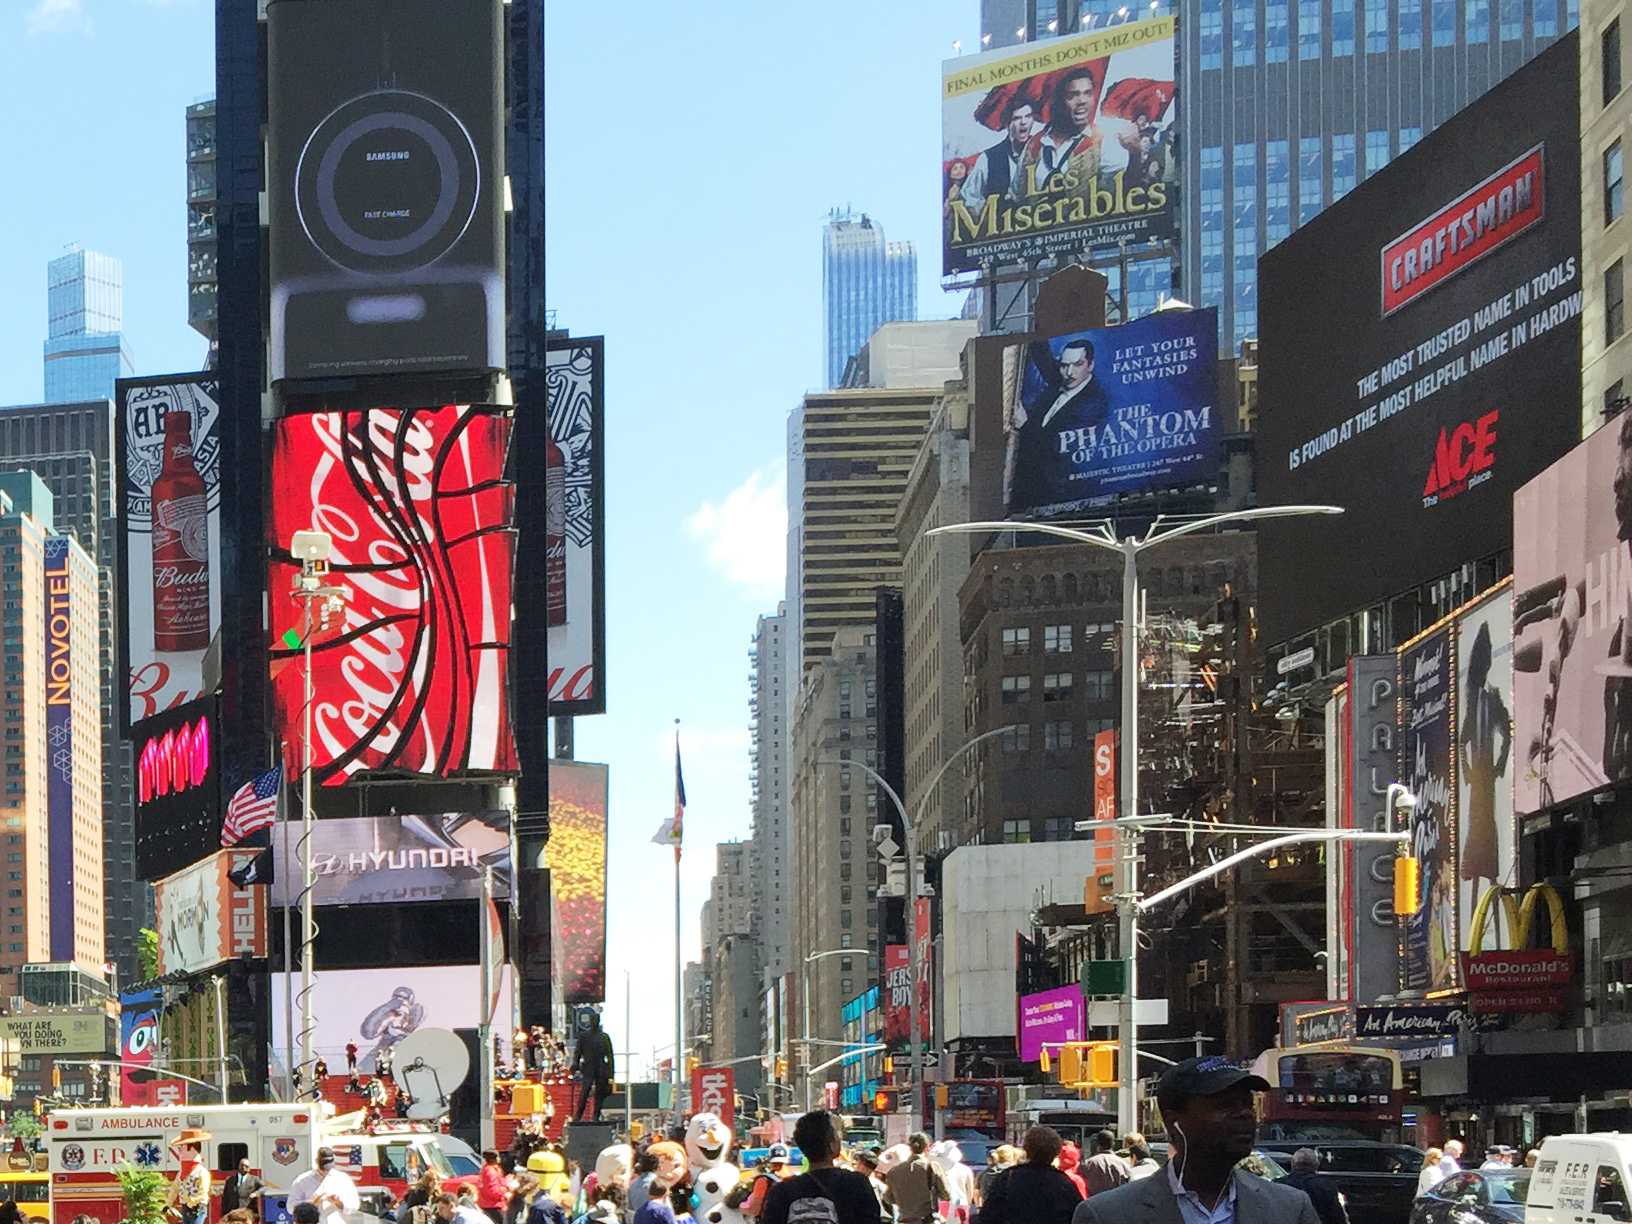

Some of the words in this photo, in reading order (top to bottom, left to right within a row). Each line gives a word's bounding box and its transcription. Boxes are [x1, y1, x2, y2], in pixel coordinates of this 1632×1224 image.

[946, 73, 987, 94] FINAL
[1056, 40, 1100, 63] DON'T
[1104, 32, 1130, 50] MIZ
[1132, 22, 1168, 41] OUT!
[366, 151, 410, 161] SAMSUNG
[1025, 164, 1079, 198] Les
[950, 171, 1167, 244] Misérables
[1097, 219, 1149, 235] THEATRE
[1391, 172, 1533, 291] CRAFTSMAN
[1356, 373, 1379, 399] THE
[1381, 353, 1415, 384] MOST
[1416, 318, 1471, 367] TRUSTED
[1473, 295, 1512, 332] NAME
[1515, 282, 1530, 310] IN
[1532, 256, 1577, 302] TOOLS
[1112, 348, 1198, 374] FANTASIES
[1115, 345, 1144, 361] LET
[1150, 335, 1197, 352] YOUR
[1121, 363, 1189, 385] UNWIND
[1289, 449, 1300, 470] IS
[1302, 430, 1338, 464] FOUND
[1339, 421, 1353, 444] AT
[1355, 408, 1378, 435] THE
[1379, 389, 1411, 423] MOST
[1414, 353, 1468, 403] HELPFUL
[1470, 333, 1510, 370] NAME
[1511, 322, 1526, 349] IN
[1114, 403, 1153, 421] THE
[1058, 405, 1213, 454] PHANTOM
[1071, 447, 1097, 464] OF
[1098, 440, 1135, 459] THE
[1136, 431, 1197, 454] OPERA
[1423, 408, 1499, 497] ACE
[46, 557, 71, 705] NOVOTEL
[349, 847, 479, 871] HYUNDAI
[1469, 961, 1569, 975] McDonald's
[7, 1021, 33, 1031] WHAT
[35, 1021, 52, 1030] ARE
[14, 1030, 32, 1039] YOU
[35, 1030, 63, 1039] DOING
[35, 1038, 68, 1048] THERE?
[101, 1117, 179, 1129] AMBULANCE
